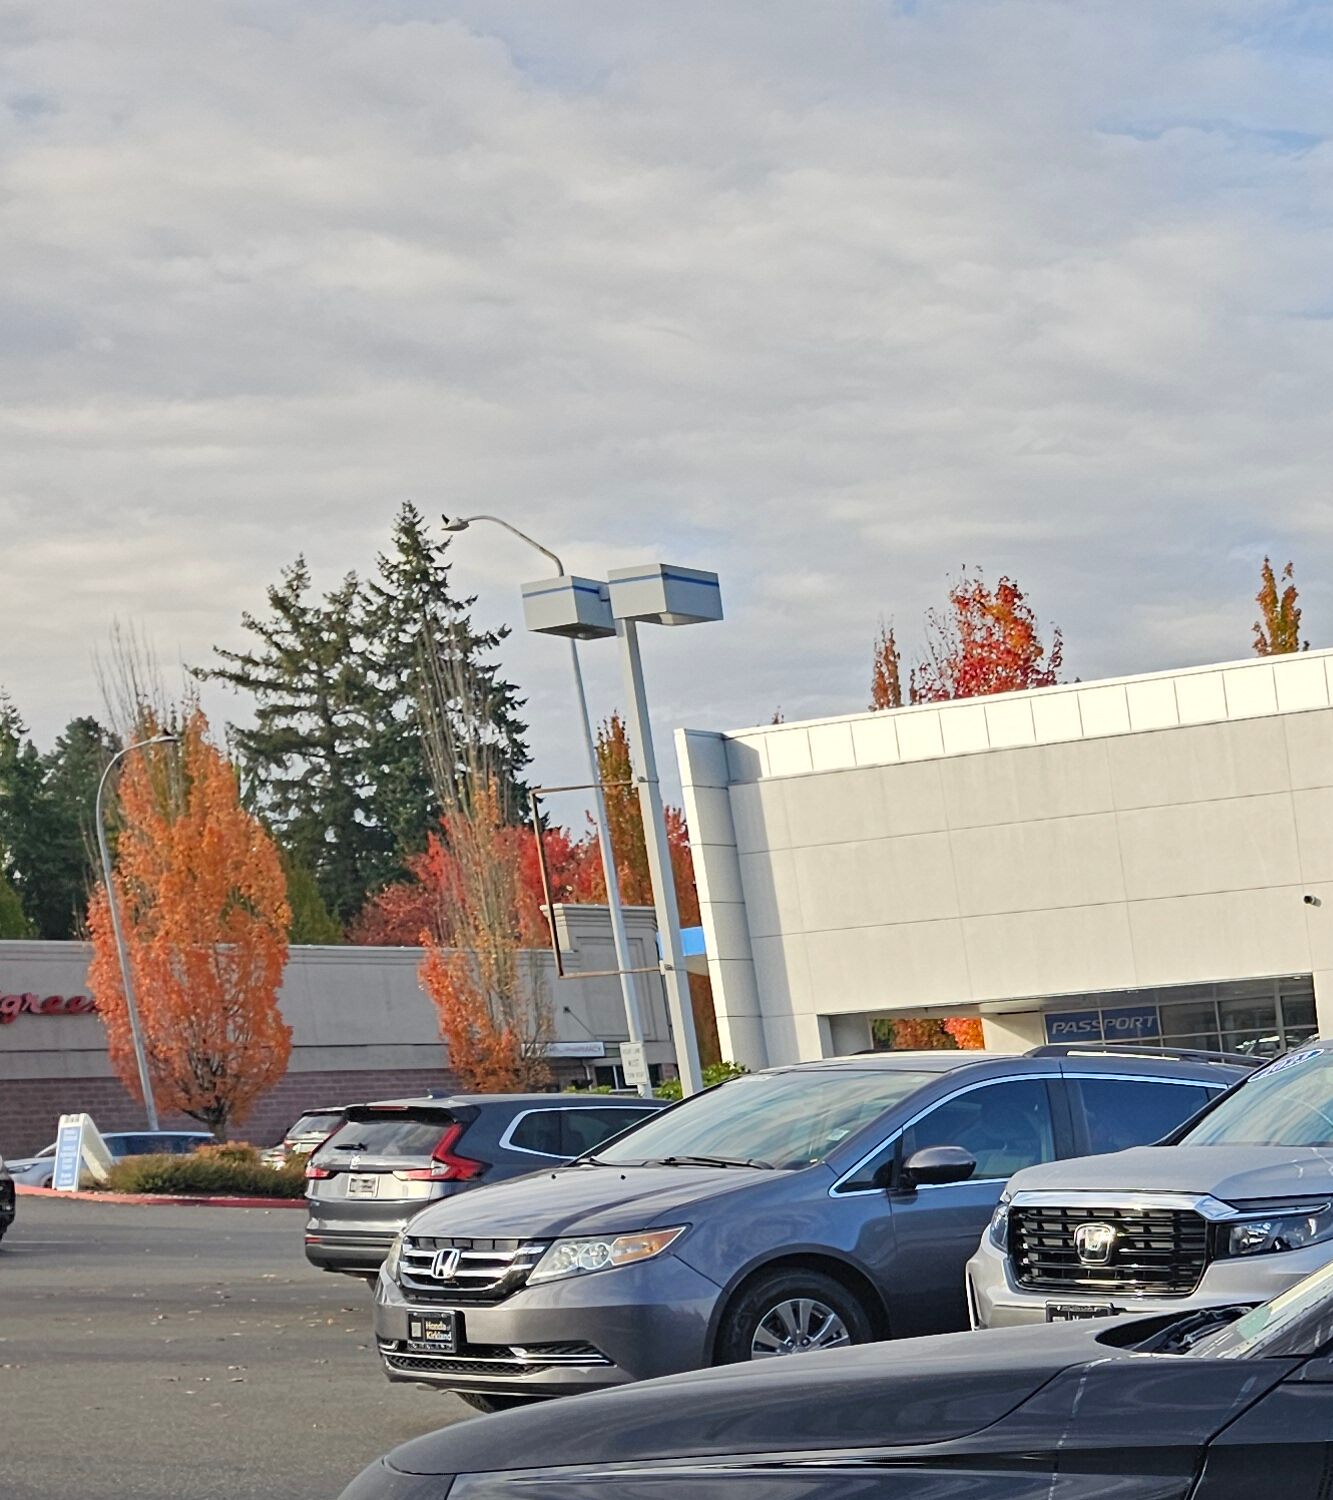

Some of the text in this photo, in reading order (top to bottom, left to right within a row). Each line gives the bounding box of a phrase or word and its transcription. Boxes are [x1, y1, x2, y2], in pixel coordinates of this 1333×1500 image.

[1052, 1015, 1157, 1035] PASSPORT
[425, 1321, 447, 1331] Honda
[426, 1330, 452, 1341] Kirkland
